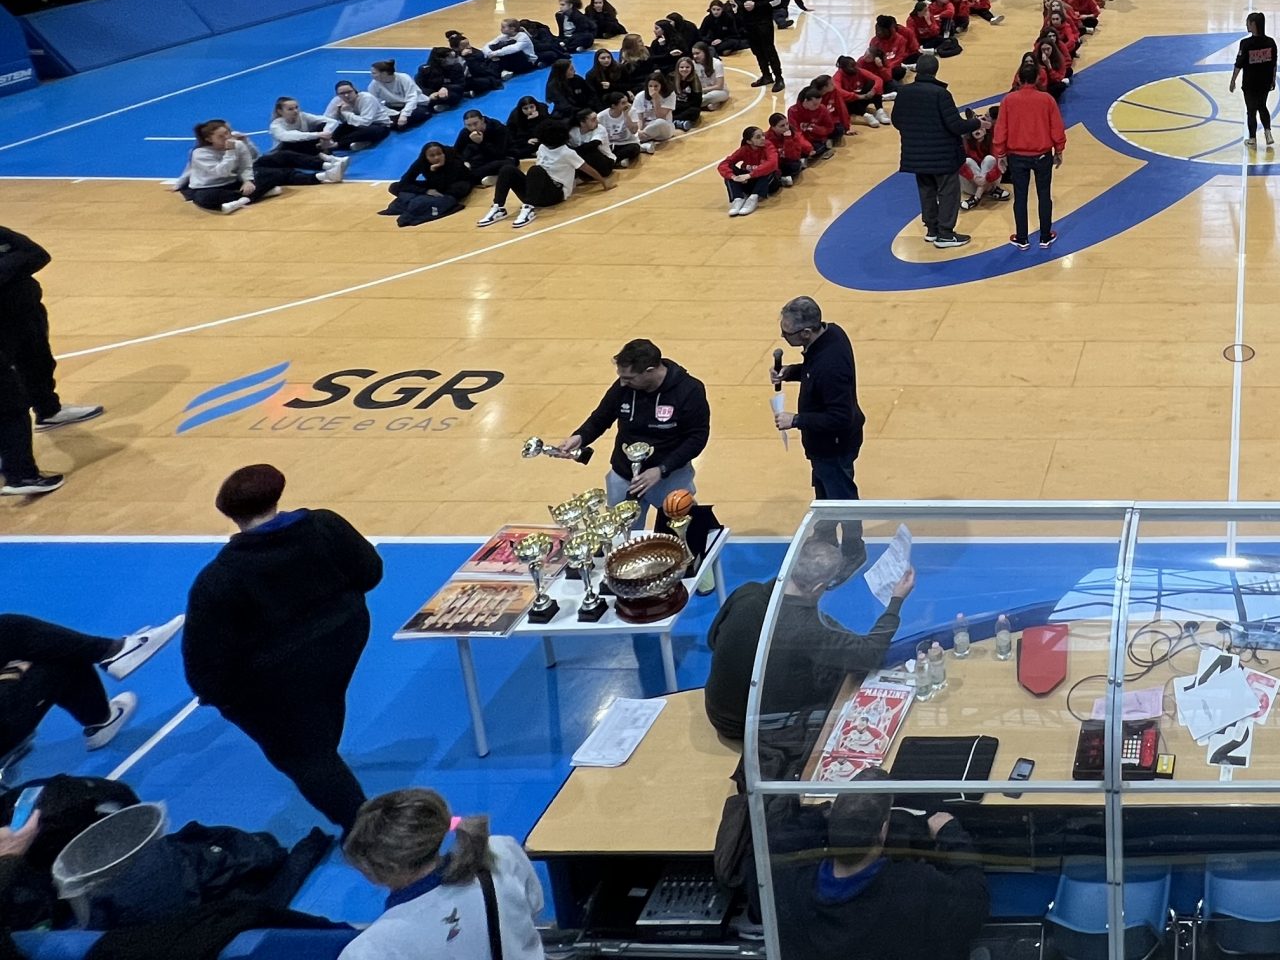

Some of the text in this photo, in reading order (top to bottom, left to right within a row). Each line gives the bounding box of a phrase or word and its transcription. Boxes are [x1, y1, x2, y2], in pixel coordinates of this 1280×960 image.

[283, 369, 505, 410] SGR
[248, 416, 460, 432] LUCE e GAS
[863, 689, 907, 700] MAGAZINE
[1209, 726, 1250, 767] 2
